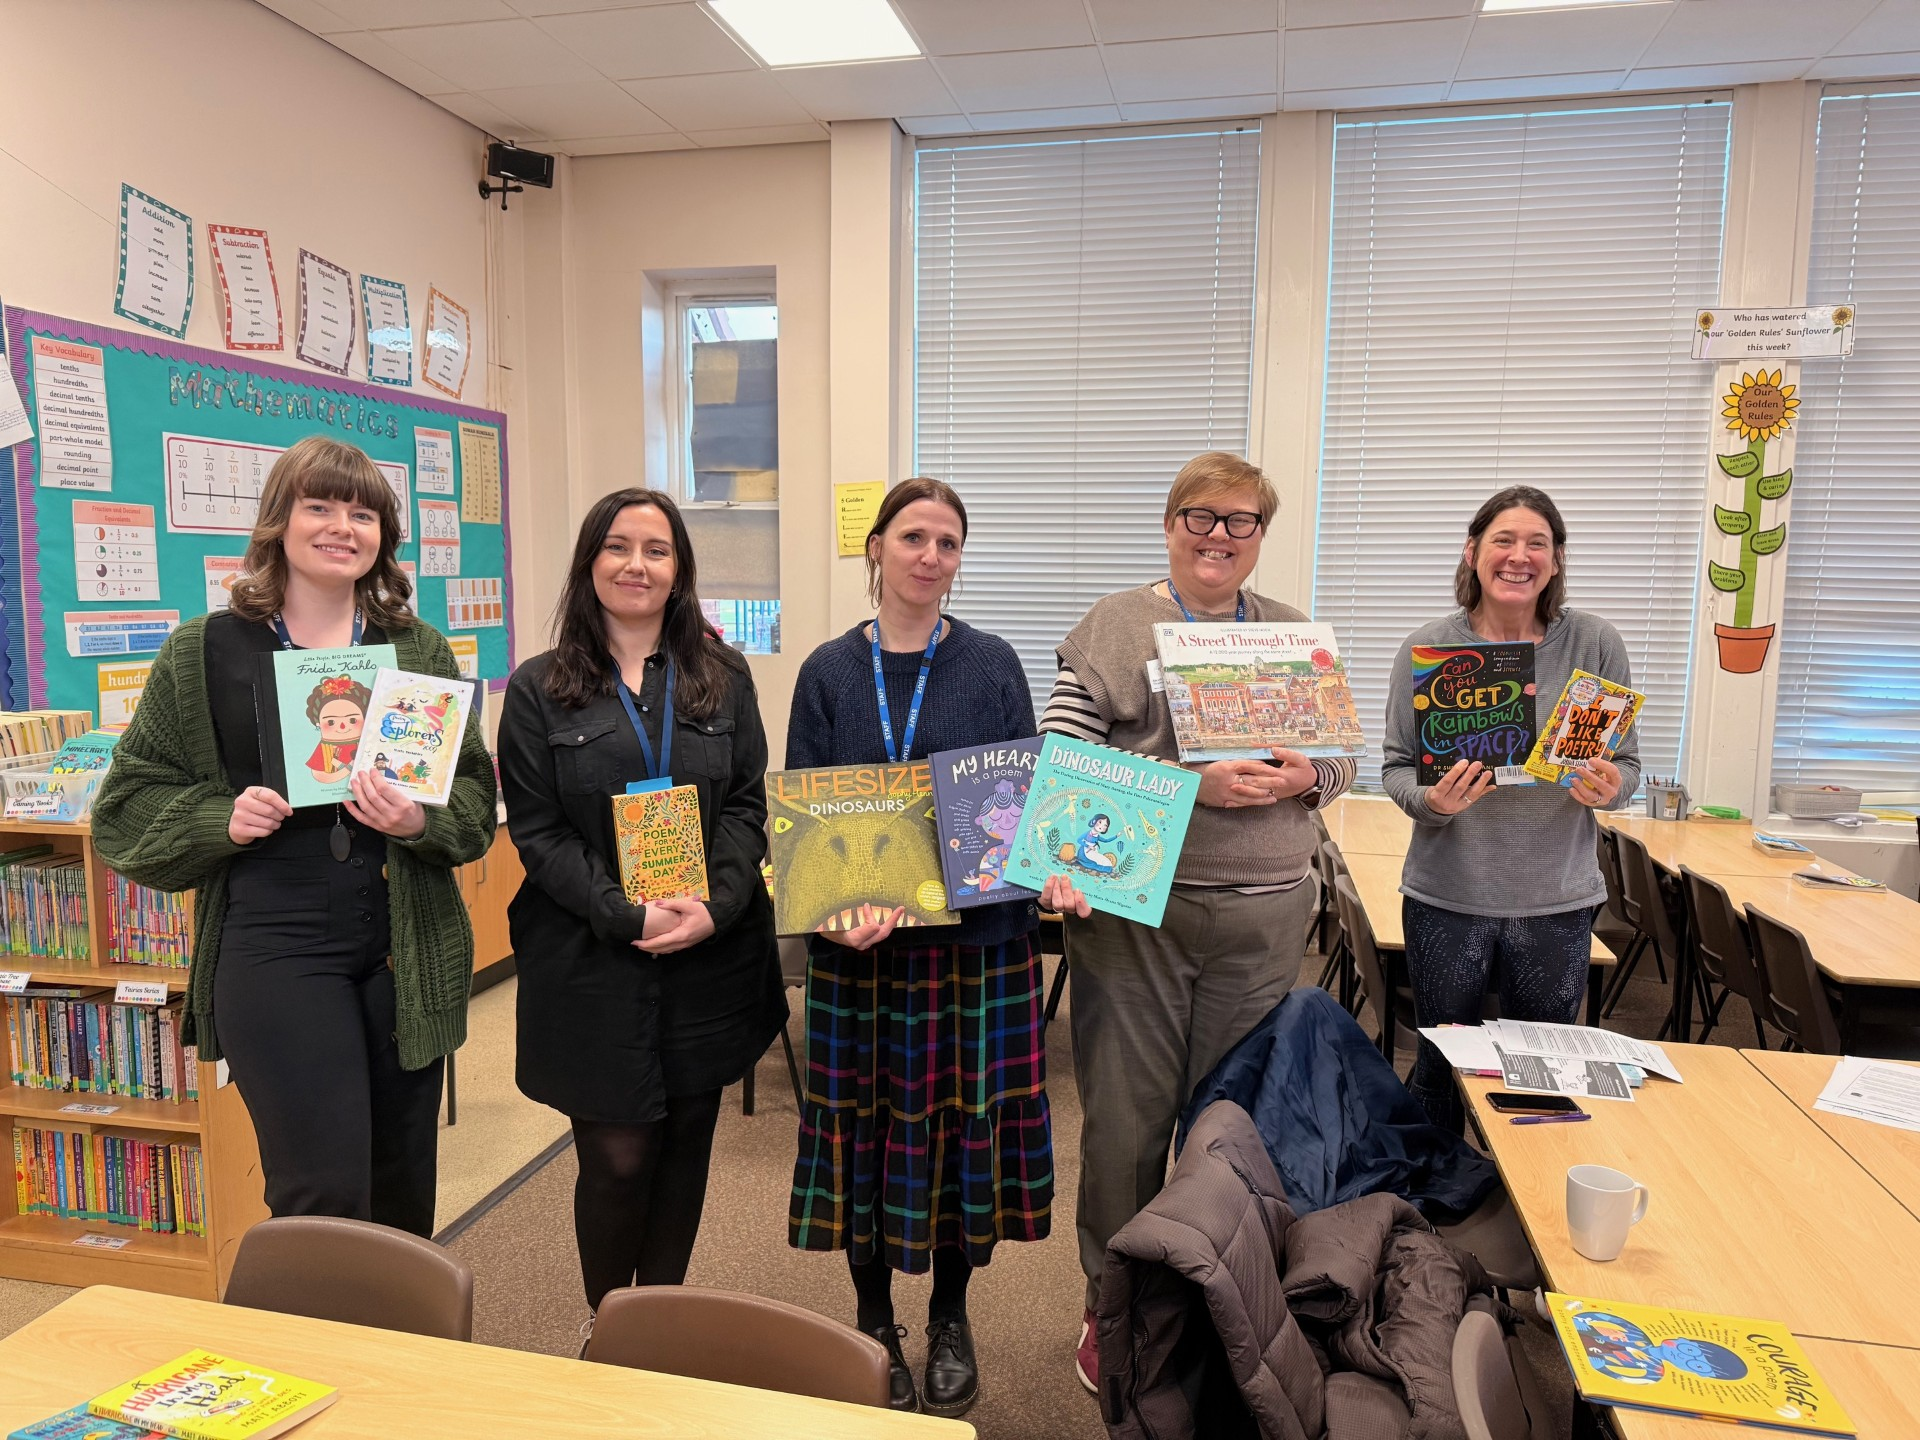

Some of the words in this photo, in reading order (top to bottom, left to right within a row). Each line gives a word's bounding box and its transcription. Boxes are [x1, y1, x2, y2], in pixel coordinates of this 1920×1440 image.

[142, 206, 175, 228] Addition
[154, 226, 164, 234] add
[222, 238, 260, 250] Subtraction
[318, 268, 336, 281] Equals
[368, 286, 402, 300] Multiplication
[142, 304, 166, 317] altogether
[1734, 314, 1752, 322] Who
[1772, 312, 1807, 321] watered
[1710, 330, 1724, 338] our
[1726, 329, 1756, 337] 'Golden
[1760, 328, 1784, 336] Rules'
[1786, 328, 1831, 336] Sunflower
[40, 343, 53, 354] Key
[56, 344, 95, 361] Vocabulary
[1766, 343, 1791, 351] week?
[60, 364, 80, 373] tenths
[53, 376, 88, 388] hundredths
[50, 390, 74, 400] decimal
[75, 394, 95, 403] tenths
[1754, 388, 1772, 396] Our
[168, 366, 398, 438] Mathematics
[1745, 400, 1778, 408] Golden
[43, 404, 67, 414] decimal
[68, 407, 104, 418] hundredths
[1748, 412, 1774, 420] Rules
[44, 418, 69, 428] decimal
[70, 422, 106, 433] equivalents
[50, 434, 84, 444] part-whole
[84, 438, 104, 446] model
[178, 444, 184, 453] 0
[206, 448, 210, 456] 1
[64, 450, 92, 460] rounding
[254, 454, 258, 462] 3
[1729, 455, 1749, 464] Respect
[56, 464, 81, 472] decimal
[82, 466, 98, 474] point
[178, 460, 188, 468] 10
[204, 462, 214, 471] 10
[230, 465, 238, 474] 10
[1726, 464, 1740, 472] each
[1740, 460, 1755, 468] other
[178, 472, 188, 480] 0%
[204, 474, 216, 482] 10%
[253, 468, 260, 476] 10
[60, 478, 78, 486] place
[78, 479, 95, 488] value
[182, 503, 188, 512] 0
[206, 504, 216, 514] 0.1
[230, 506, 240, 515] 0.2
[1721, 522, 1744, 530] property
[1714, 576, 1738, 584] problems
[932, 630, 940, 646] STAFF
[1176, 634, 1186, 647] A
[1188, 634, 1226, 648] Street
[1227, 634, 1284, 649] Through
[1285, 634, 1320, 646] Time
[297, 662, 336, 675] Frida
[337, 659, 378, 672] Kahlo
[1442, 661, 1472, 681] Can
[917, 676, 926, 694] STAFF
[1444, 676, 1478, 700] you
[878, 688, 886, 706] STAFF
[1456, 686, 1502, 708] GET
[1590, 694, 1605, 711] I
[908, 708, 918, 728] STAFF
[1429, 701, 1525, 738] Rainbows
[1568, 704, 1620, 728] DON'T
[882, 720, 892, 740] STAFF
[1566, 724, 1603, 740] LIKE
[64, 746, 110, 754] MINECRAFT
[1434, 736, 1452, 749] in
[1454, 730, 1530, 762] SPACE?
[1555, 737, 1606, 758] POETRY
[952, 756, 978, 784] MY
[1049, 744, 1134, 788] DINOSAUR
[1135, 768, 1184, 801] LADY
[1060, 772, 1074, 780] Daring
[777, 764, 932, 800] LIFESIZE
[971, 776, 980, 785] is
[983, 772, 990, 780] a
[994, 768, 1023, 780] poem
[888, 788, 912, 800] Sophy
[810, 800, 906, 816] DINOSAURS
[644, 828, 678, 840] POEM
[654, 838, 668, 846] FOR
[644, 844, 680, 858] EVERY
[642, 855, 686, 870] SUMMER
[653, 867, 676, 878] DAY
[978, 894, 998, 902] poetry
[1001, 890, 1019, 898] about
[124, 986, 144, 994] Fairies
[144, 986, 160, 994] Series
[14, 1130, 20, 1138] JO
[1564, 1326, 1576, 1340] about
[1571, 1340, 1588, 1376] empowerment
[1744, 1346, 1756, 1354] in
[1757, 1356, 1766, 1364] a
[1746, 1334, 1818, 1416] COURAGE
[1758, 1365, 1778, 1390] poem
[120, 1355, 224, 1412] HURRICANE
[132, 1380, 150, 1390] A
[156, 1395, 184, 1408] In
[179, 1382, 214, 1396] My
[184, 1376, 246, 1408] Head
[240, 1412, 270, 1428] MATT
[271, 1392, 307, 1412] ABBOTT
[100, 1406, 134, 1424] HURRICANE
[140, 1418, 150, 1427] MY
[150, 1420, 163, 1430] HEAD
